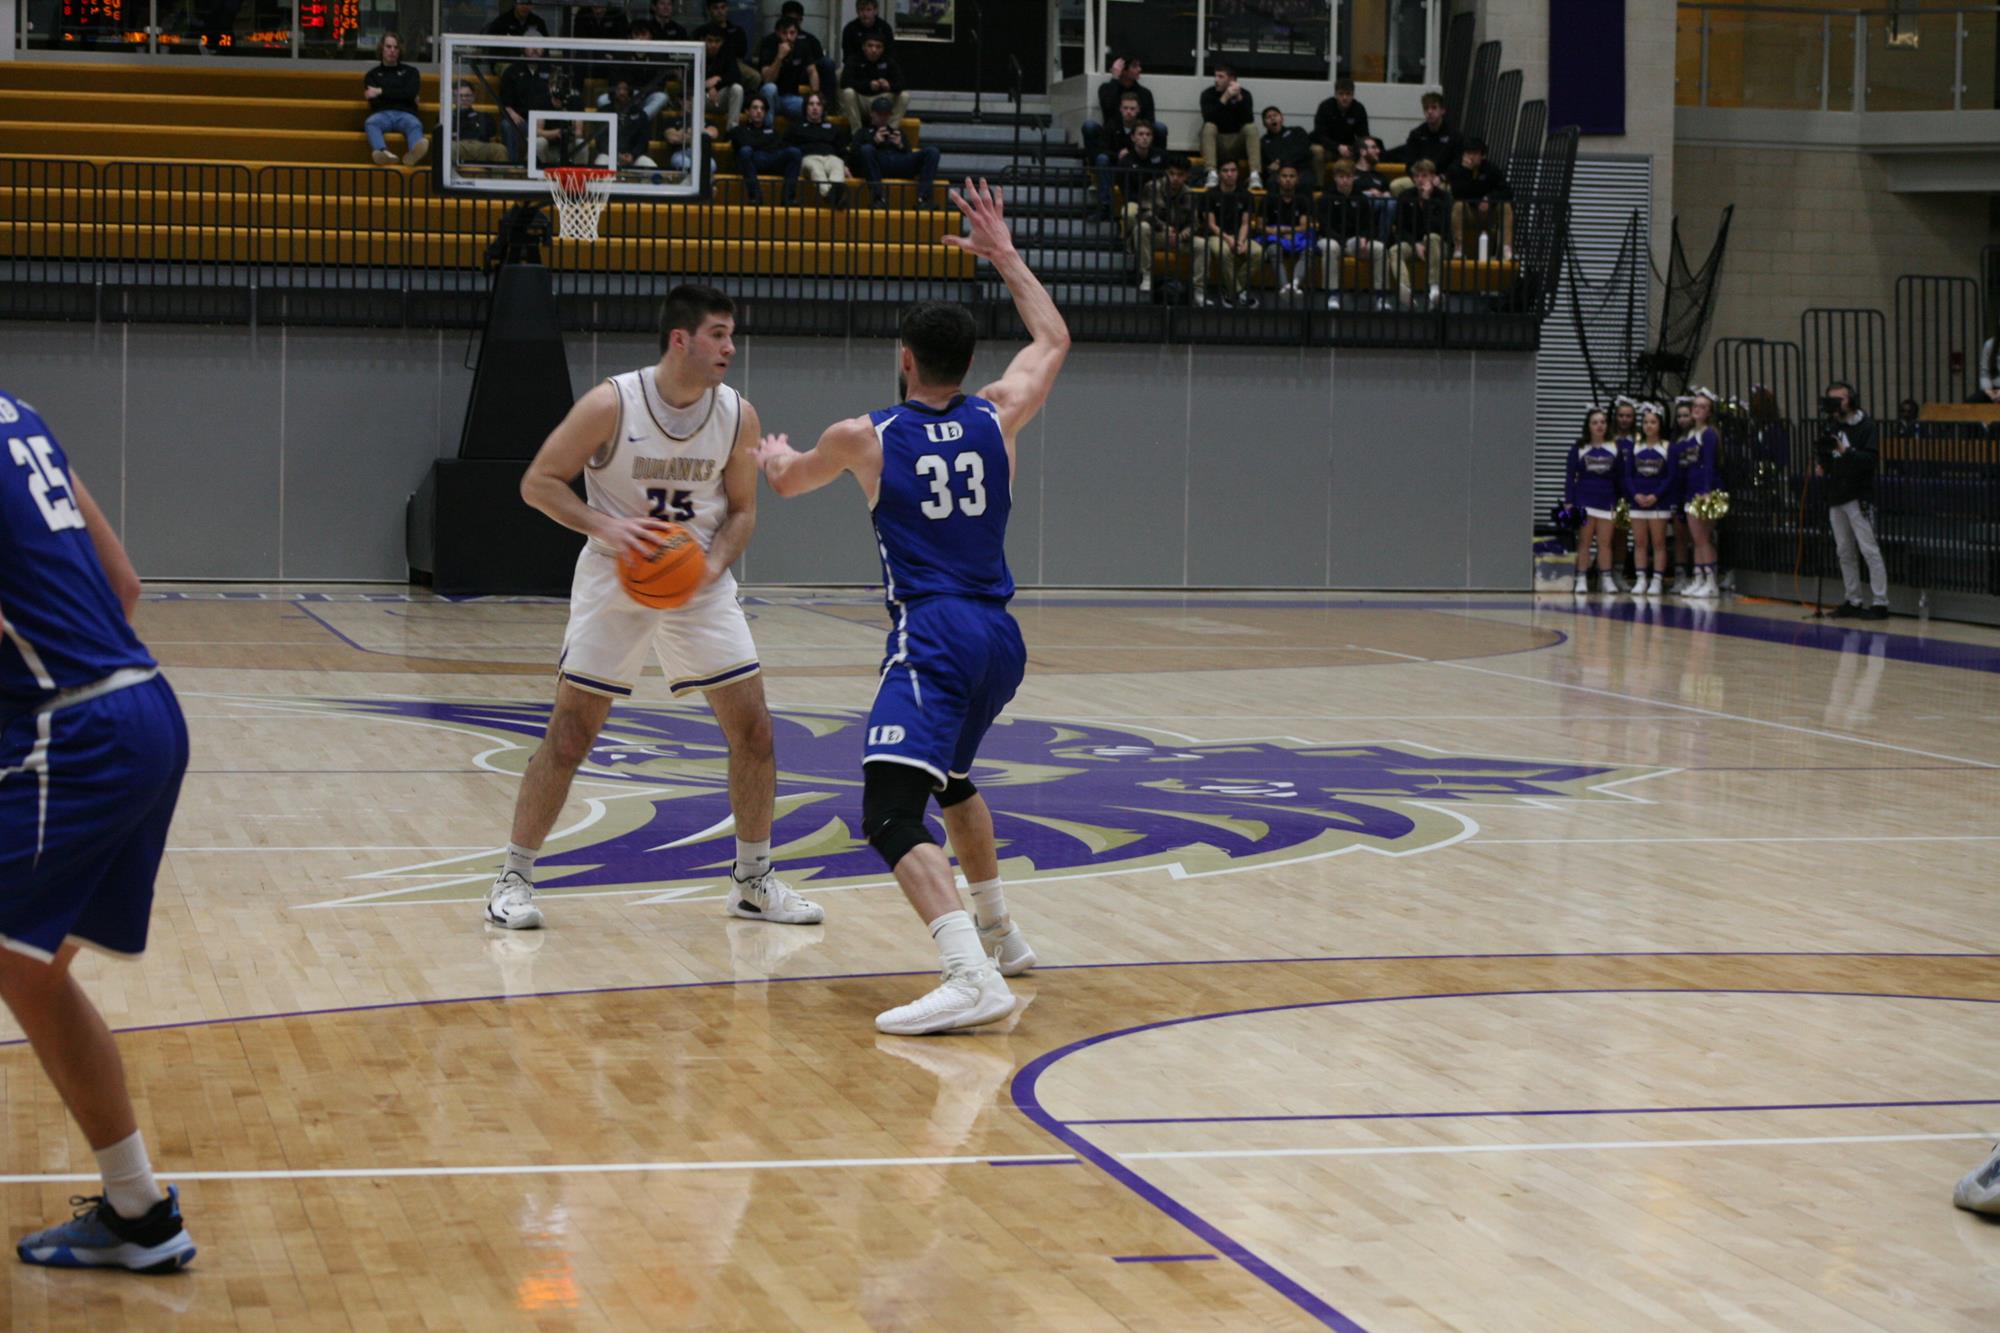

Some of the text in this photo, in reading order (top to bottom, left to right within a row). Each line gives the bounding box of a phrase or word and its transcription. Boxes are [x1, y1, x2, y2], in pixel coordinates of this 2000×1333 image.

[923, 421, 963, 442] UD
[8, 435, 86, 532] 25
[915, 451, 986, 519] 33
[646, 488, 695, 521] 25
[868, 725, 906, 746] UD
